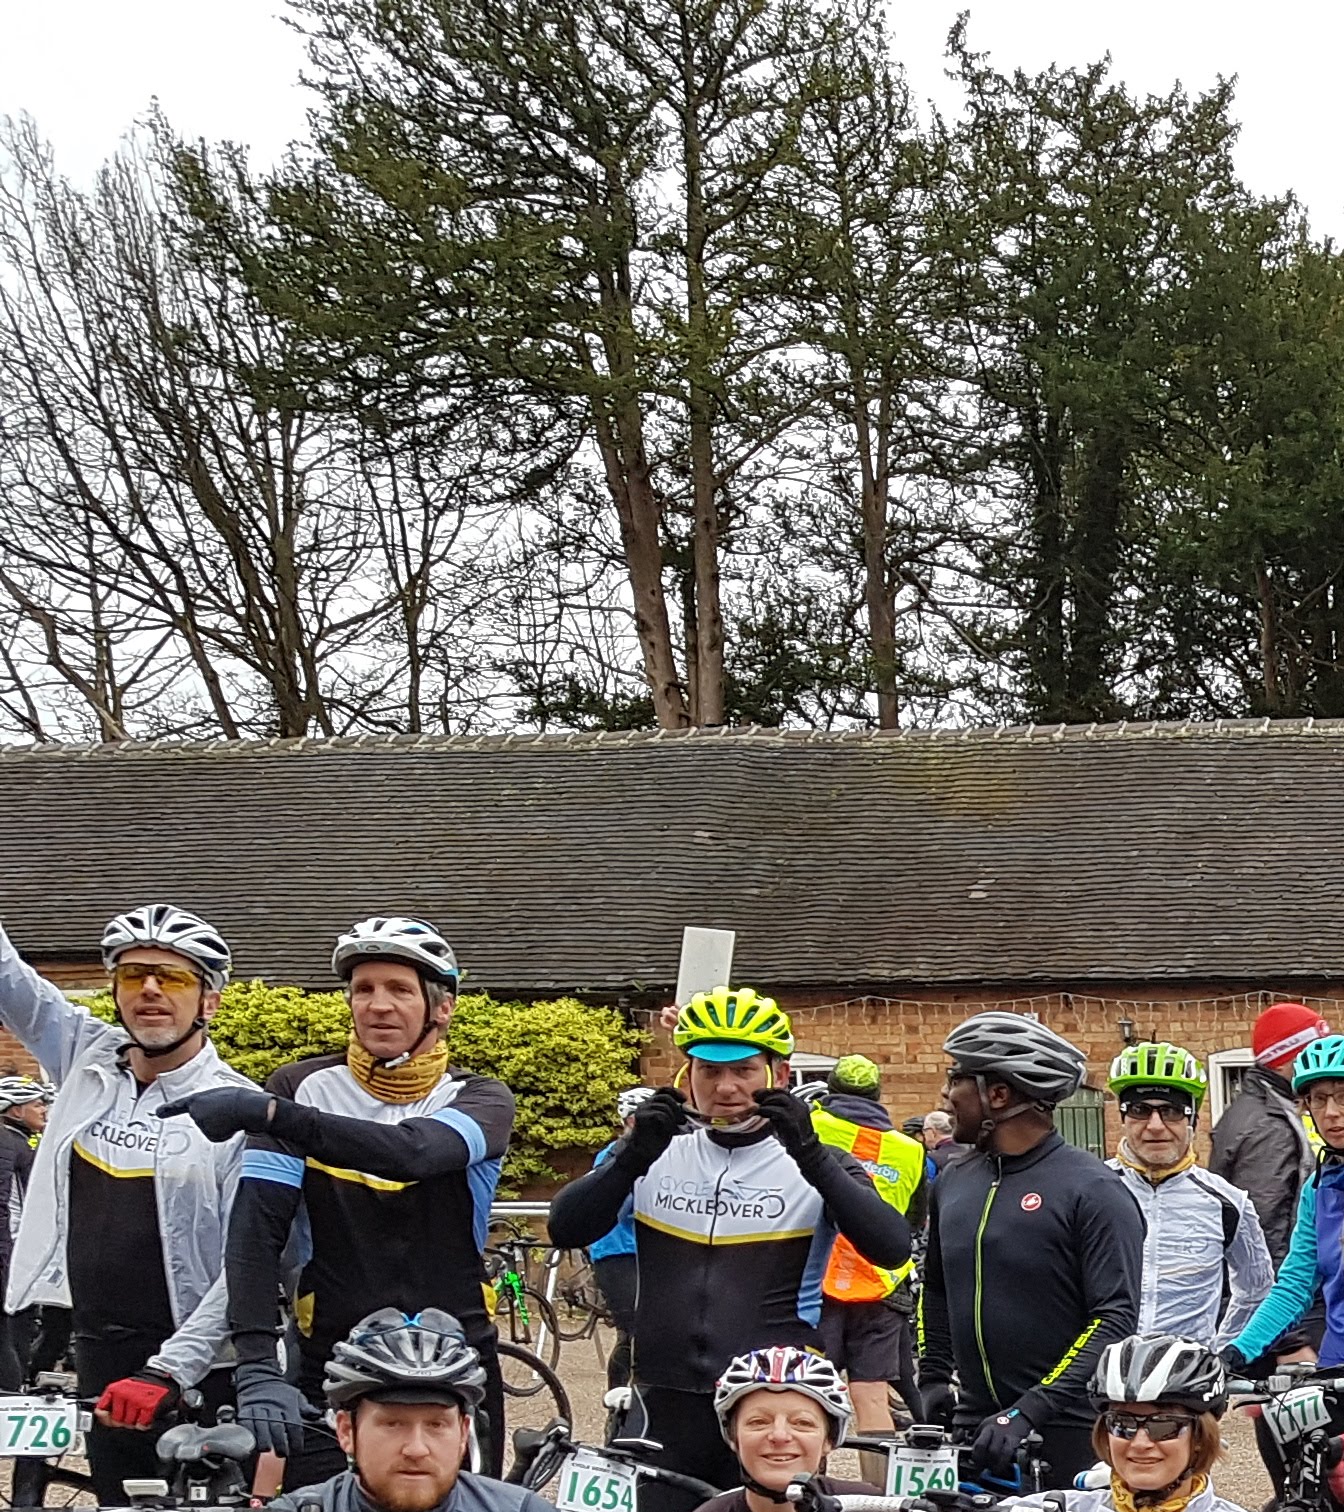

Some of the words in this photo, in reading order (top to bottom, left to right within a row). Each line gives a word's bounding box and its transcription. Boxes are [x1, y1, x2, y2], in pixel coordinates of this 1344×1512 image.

[659, 1176, 716, 1197] CYCLE
[655, 1191, 764, 1219] MICKLEOVER
[1271, 1395, 1321, 1435] 1777
